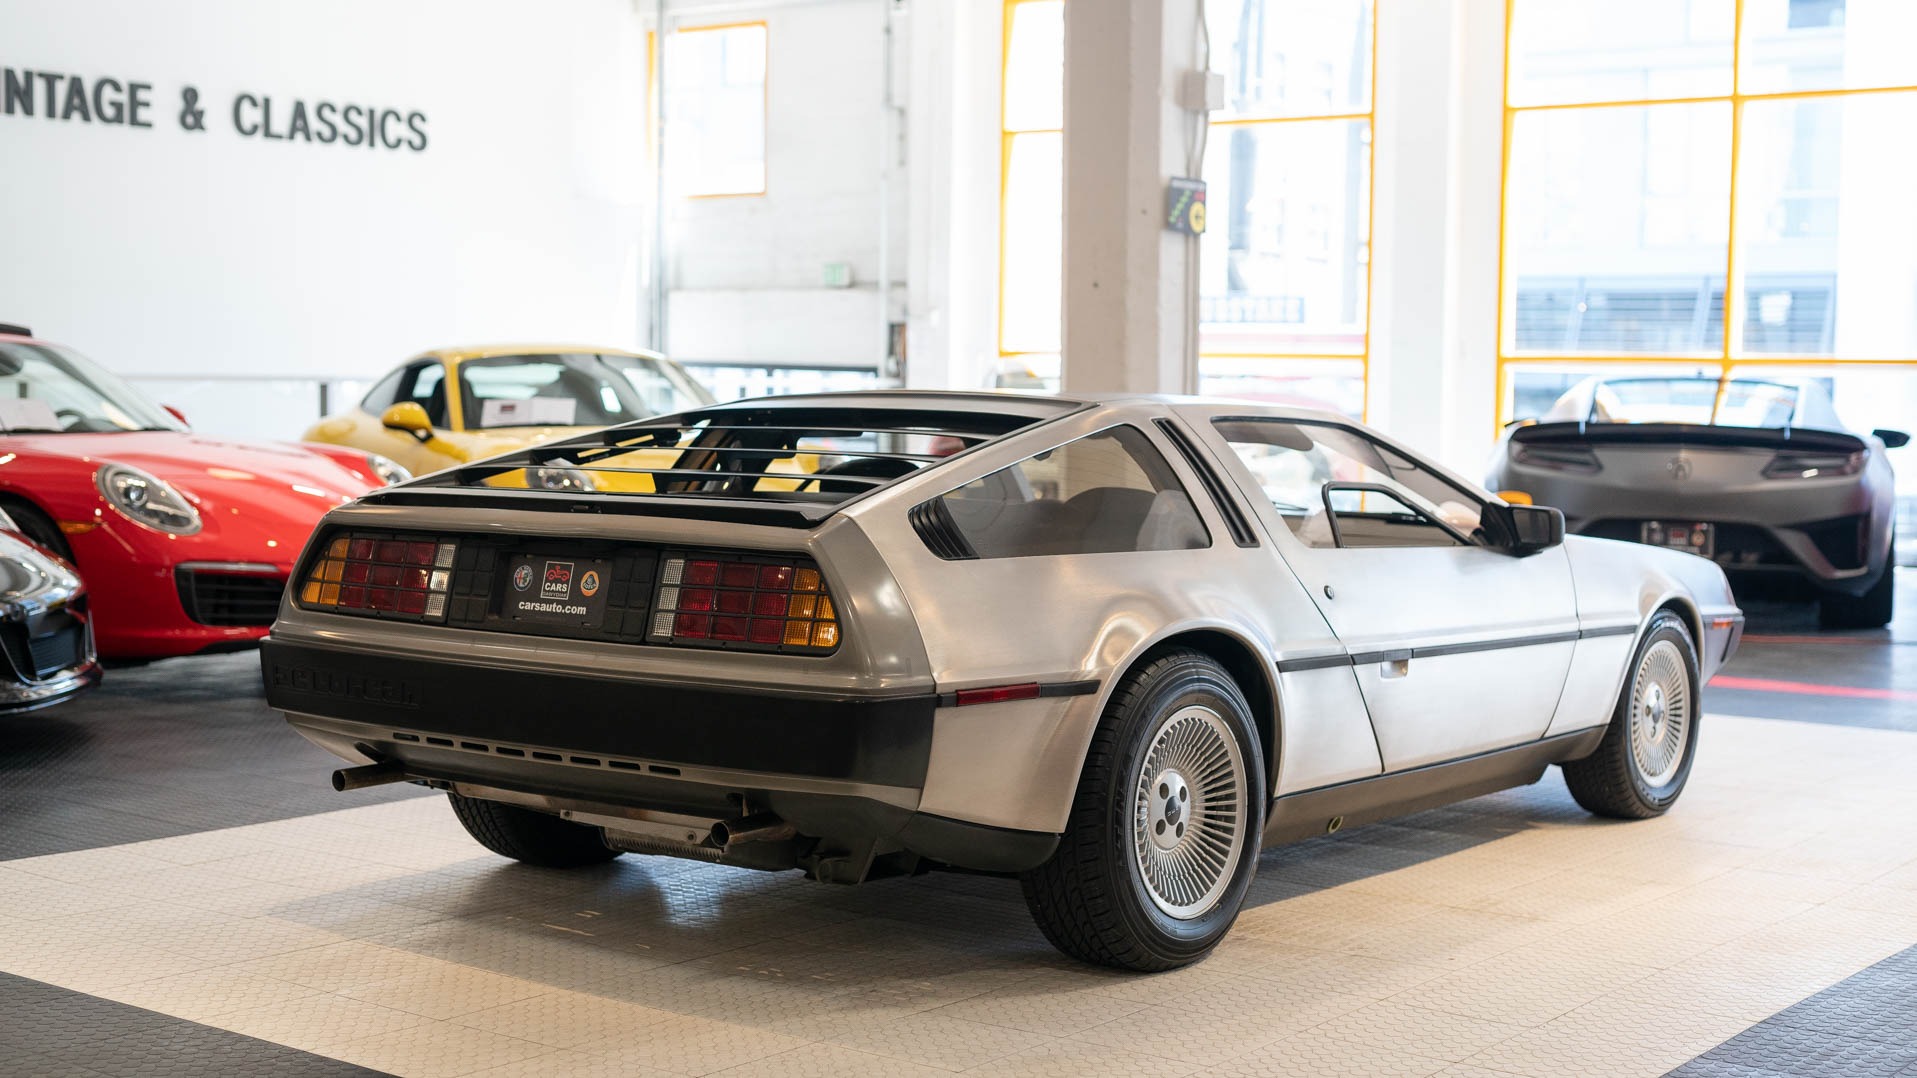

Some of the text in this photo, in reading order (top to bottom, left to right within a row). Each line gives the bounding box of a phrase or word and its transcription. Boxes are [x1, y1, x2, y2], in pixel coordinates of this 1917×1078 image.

[0, 66, 429, 152] NTAGE & CLASSICS
[545, 582, 568, 591] CARS
[518, 601, 587, 615] carsauto.com
